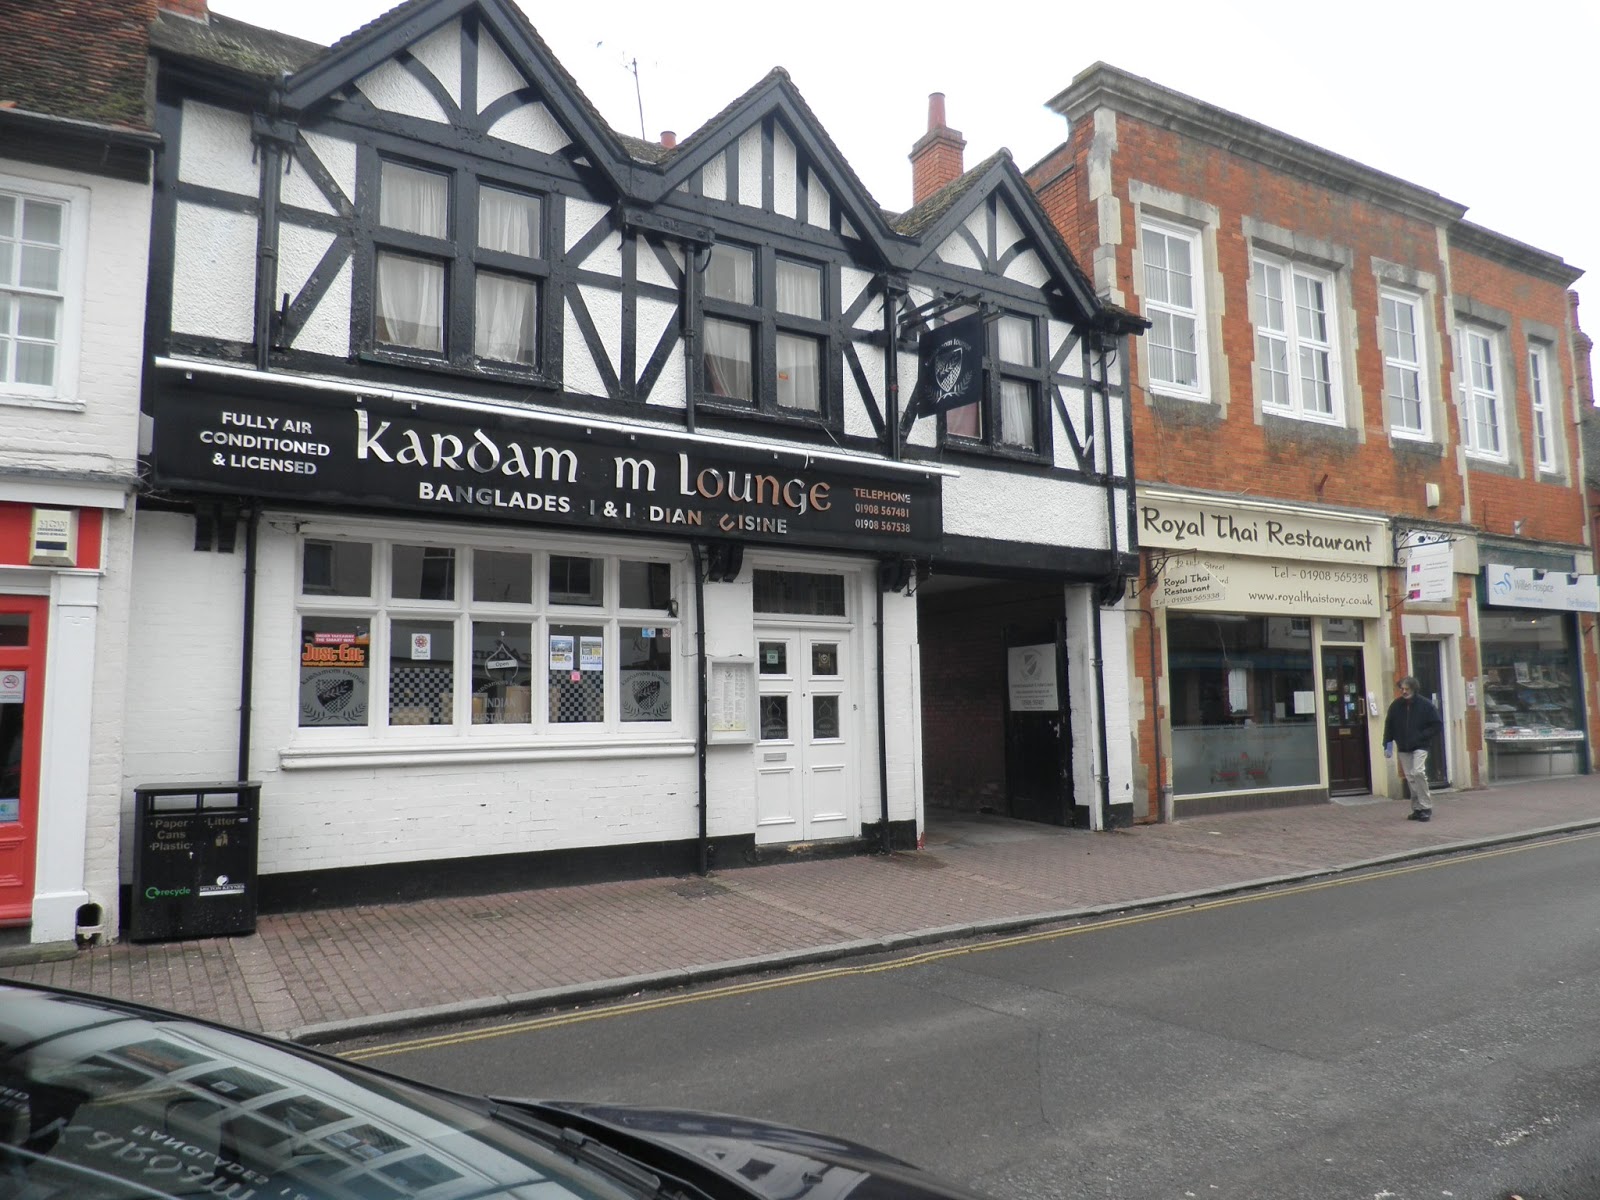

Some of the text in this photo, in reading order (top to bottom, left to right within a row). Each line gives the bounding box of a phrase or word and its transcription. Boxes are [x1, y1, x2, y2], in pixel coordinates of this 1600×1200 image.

[221, 411, 312, 435] FULLY AIR
[199, 431, 330, 457] CONDITIONED
[212, 454, 317, 476] & LICENSED
[678, 453, 832, 515] Lounge
[418, 481, 570, 513] BANGLADES
[603, 501, 618, 517] &
[649, 505, 702, 526] DIAN
[853, 487, 911, 504] TELEPHONE
[855, 503, 909, 518] 01908 567481
[855, 519, 911, 533] 01908 567538
[1140, 506, 1372, 552] Royal Thai Restaurant
[1163, 575, 1188, 587] Royal
[1190, 573, 1210, 583] Thai
[1271, 565, 1289, 579] Tel
[1300, 570, 1331, 582] 01908
[1334, 573, 1369, 584] 565338
[1164, 584, 1210, 596] Restaurant
[1248, 589, 1373, 607] www.royalthaistony.co.uk
[155, 819, 189, 829] Paper
[207, 817, 236, 826] Litter
[157, 830, 186, 840] Cans
[152, 842, 191, 851] Plastic
[160, 886, 191, 898] recycle
